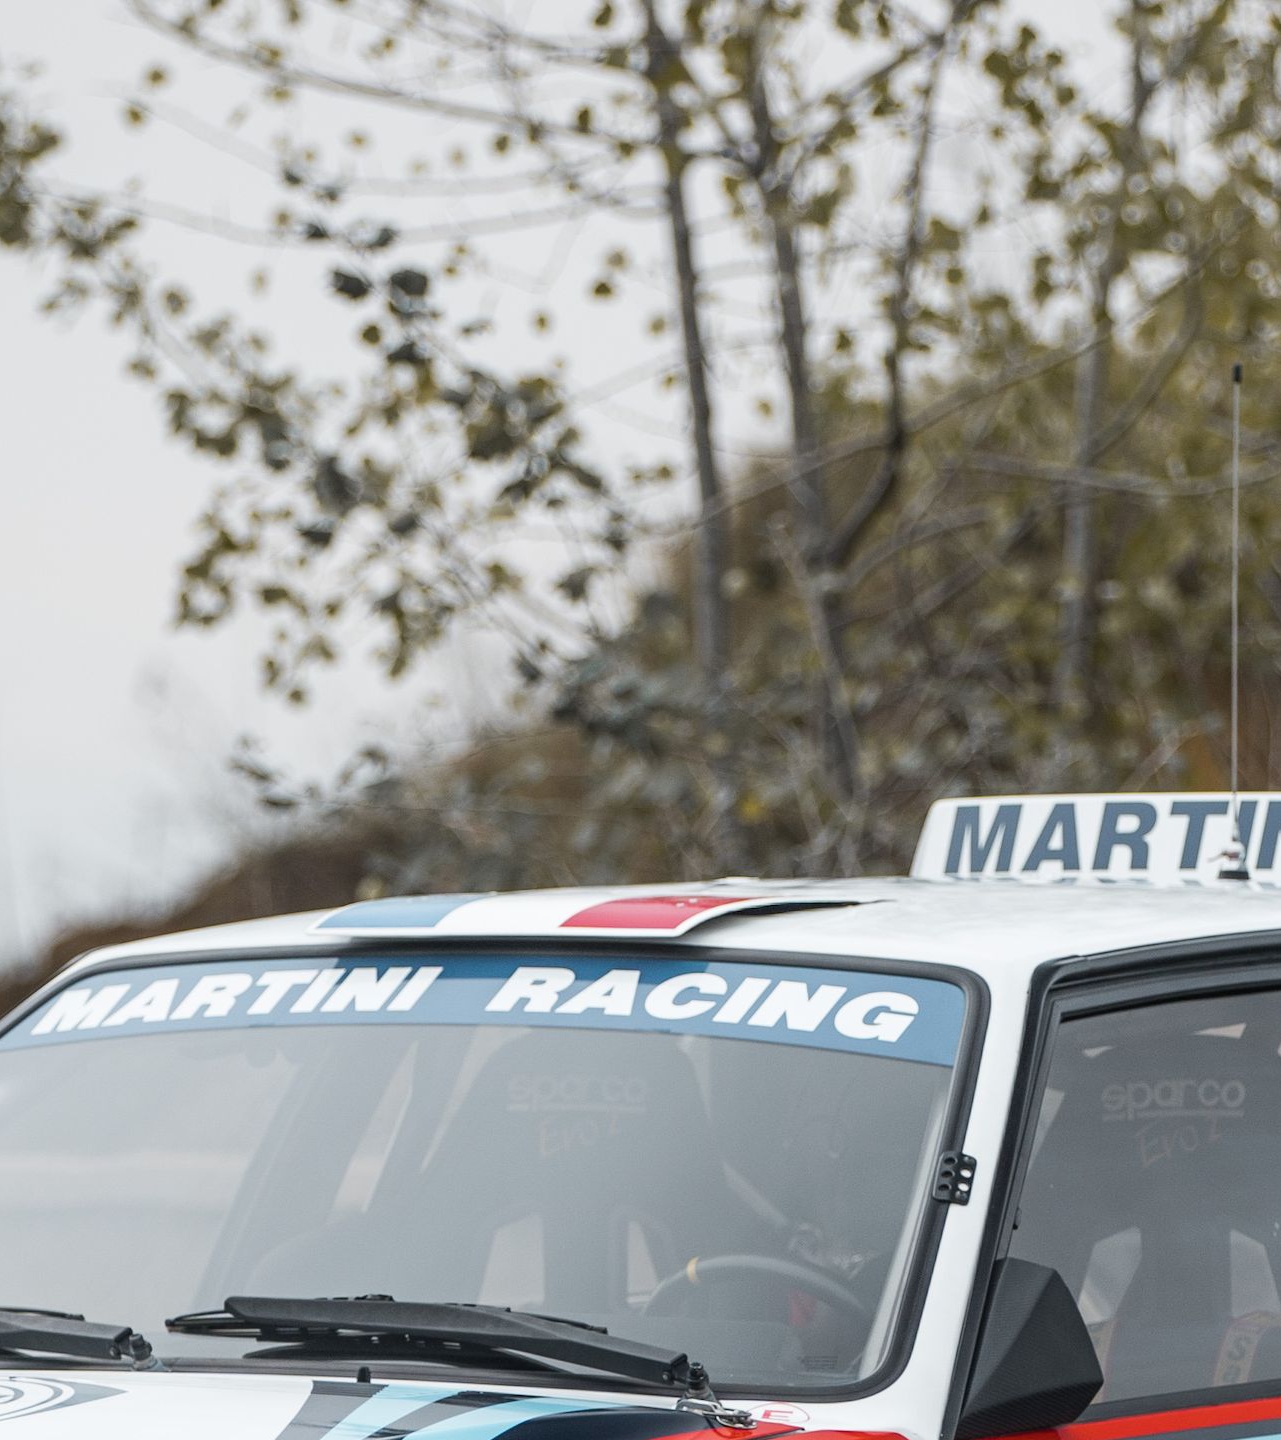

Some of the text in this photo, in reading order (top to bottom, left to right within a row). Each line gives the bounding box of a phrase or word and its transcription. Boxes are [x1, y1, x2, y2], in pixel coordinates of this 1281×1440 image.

[30, 965, 919, 1043] MARTINI RACING
[1100, 1078, 1247, 1121] sparco
